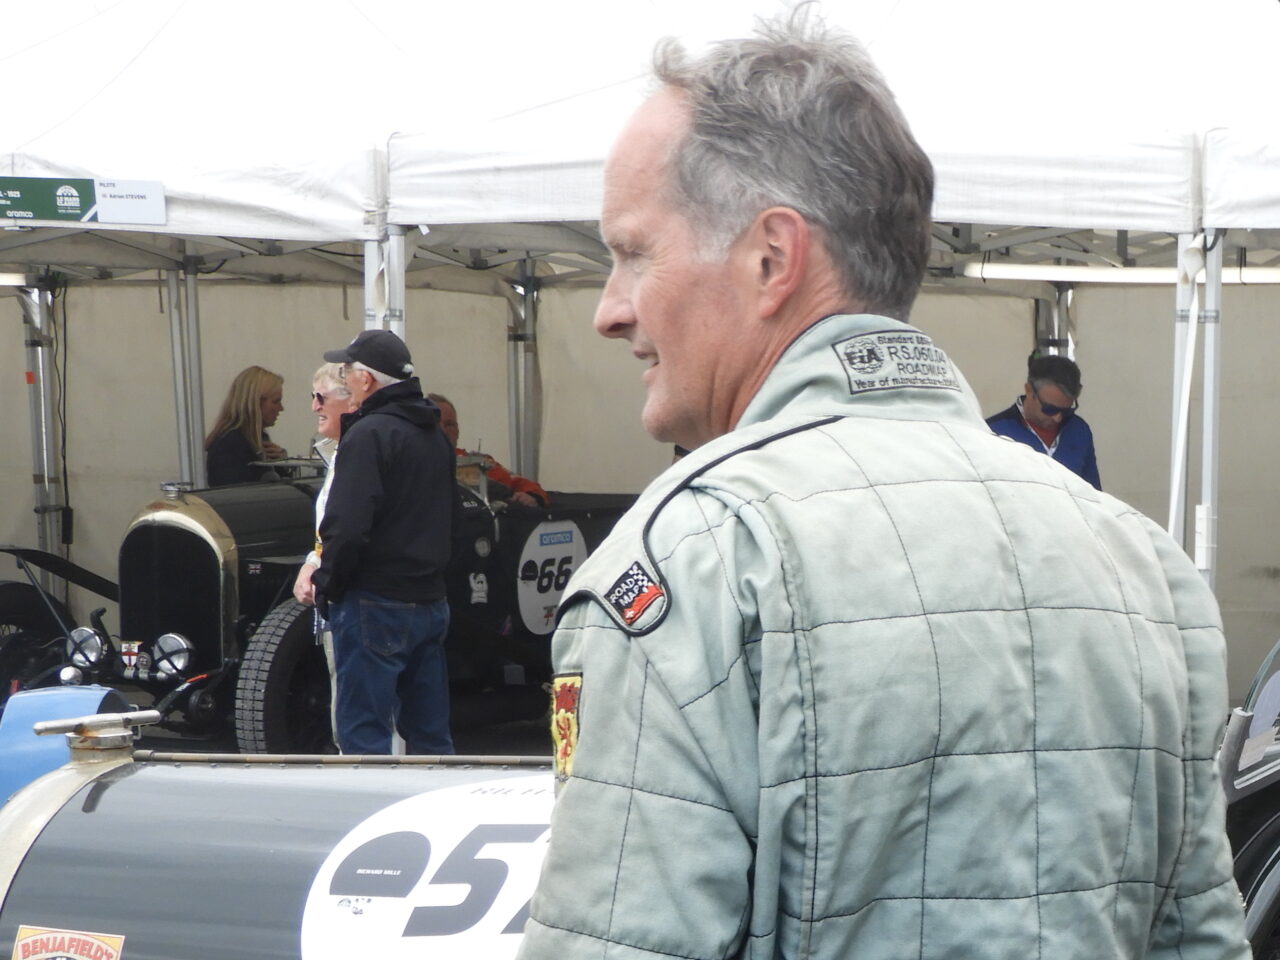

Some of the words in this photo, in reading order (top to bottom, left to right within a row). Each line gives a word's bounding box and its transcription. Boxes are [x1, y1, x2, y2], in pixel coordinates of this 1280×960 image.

[6, 210, 34, 218] aramco
[854, 378, 877, 389] Year
[879, 377, 890, 387] of
[537, 556, 573, 594] 66
[610, 578, 636, 603] ROAD
[619, 585, 640, 606] MAP
